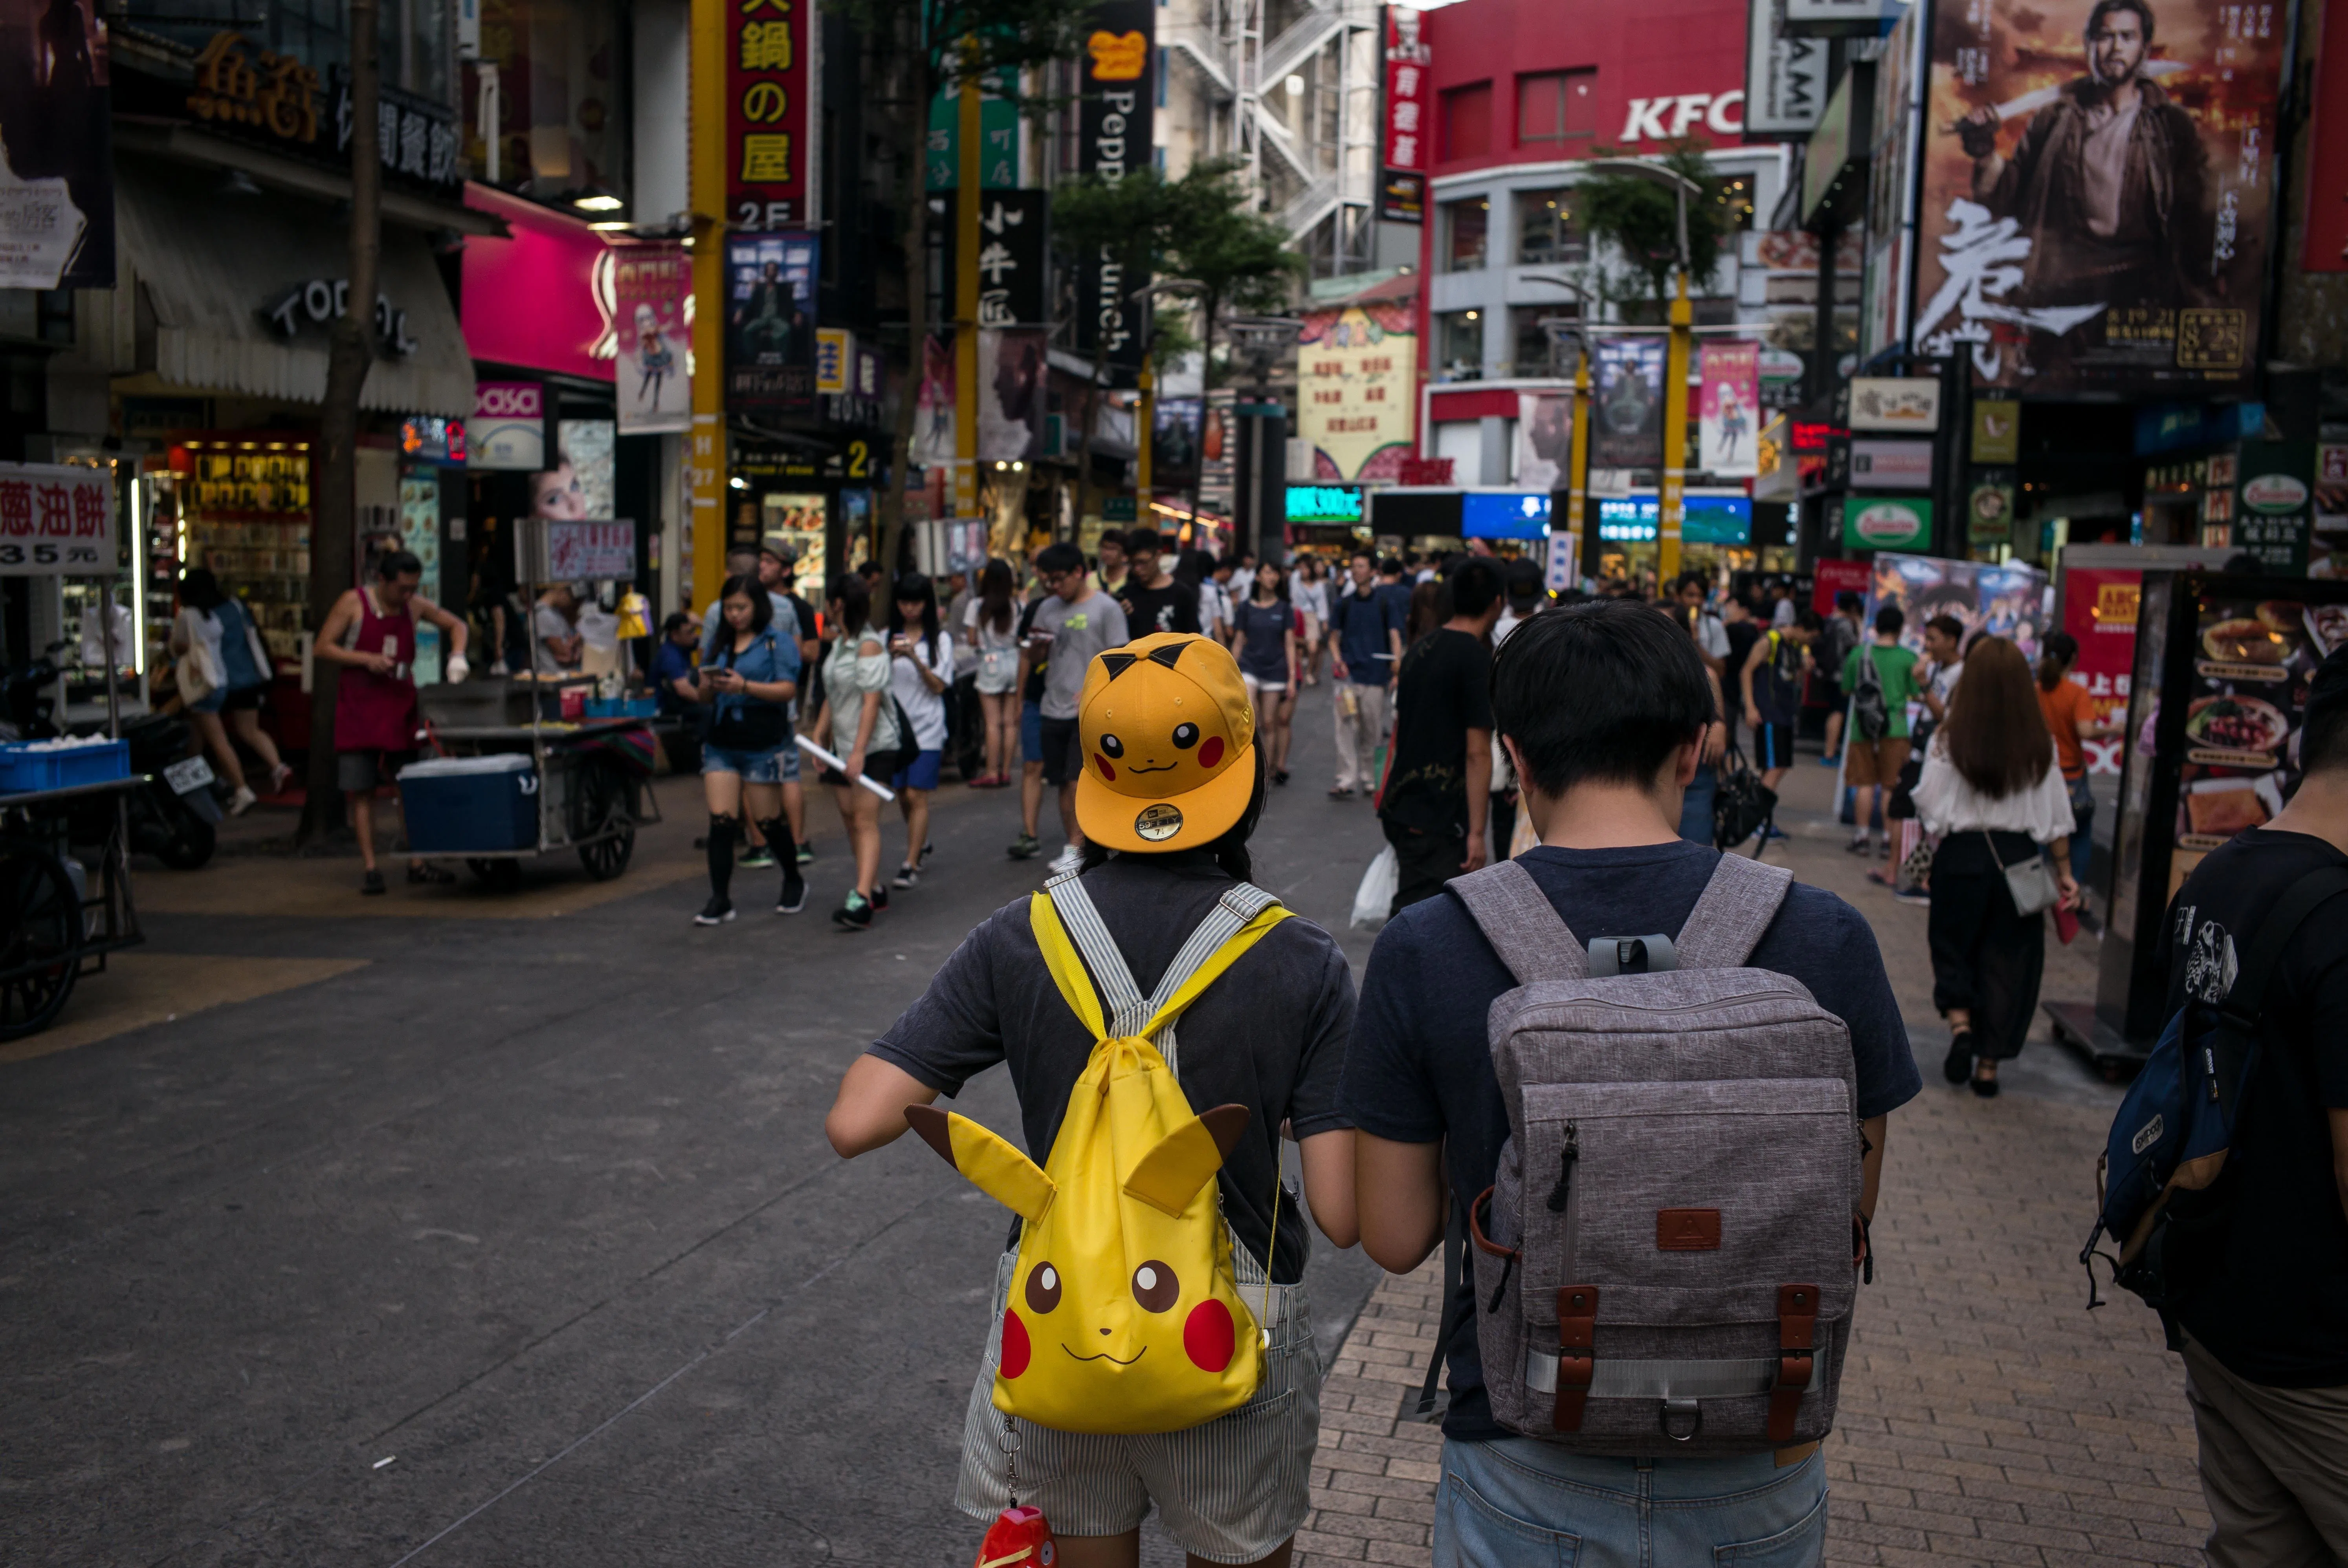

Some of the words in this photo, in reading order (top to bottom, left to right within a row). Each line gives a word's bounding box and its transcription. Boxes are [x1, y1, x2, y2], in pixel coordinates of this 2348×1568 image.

[1619, 90, 1744, 143] KFC
[928, 128, 1013, 151] 西町
[1095, 89, 1135, 190] Pepp
[738, 201, 791, 231] 2F
[695, 435, 713, 457] H
[692, 468, 715, 488] 27
[0, 482, 106, 539] 蔥油餅
[0, 544, 99, 565] 35元
[1139, 816, 1179, 829] 59FIFTY
